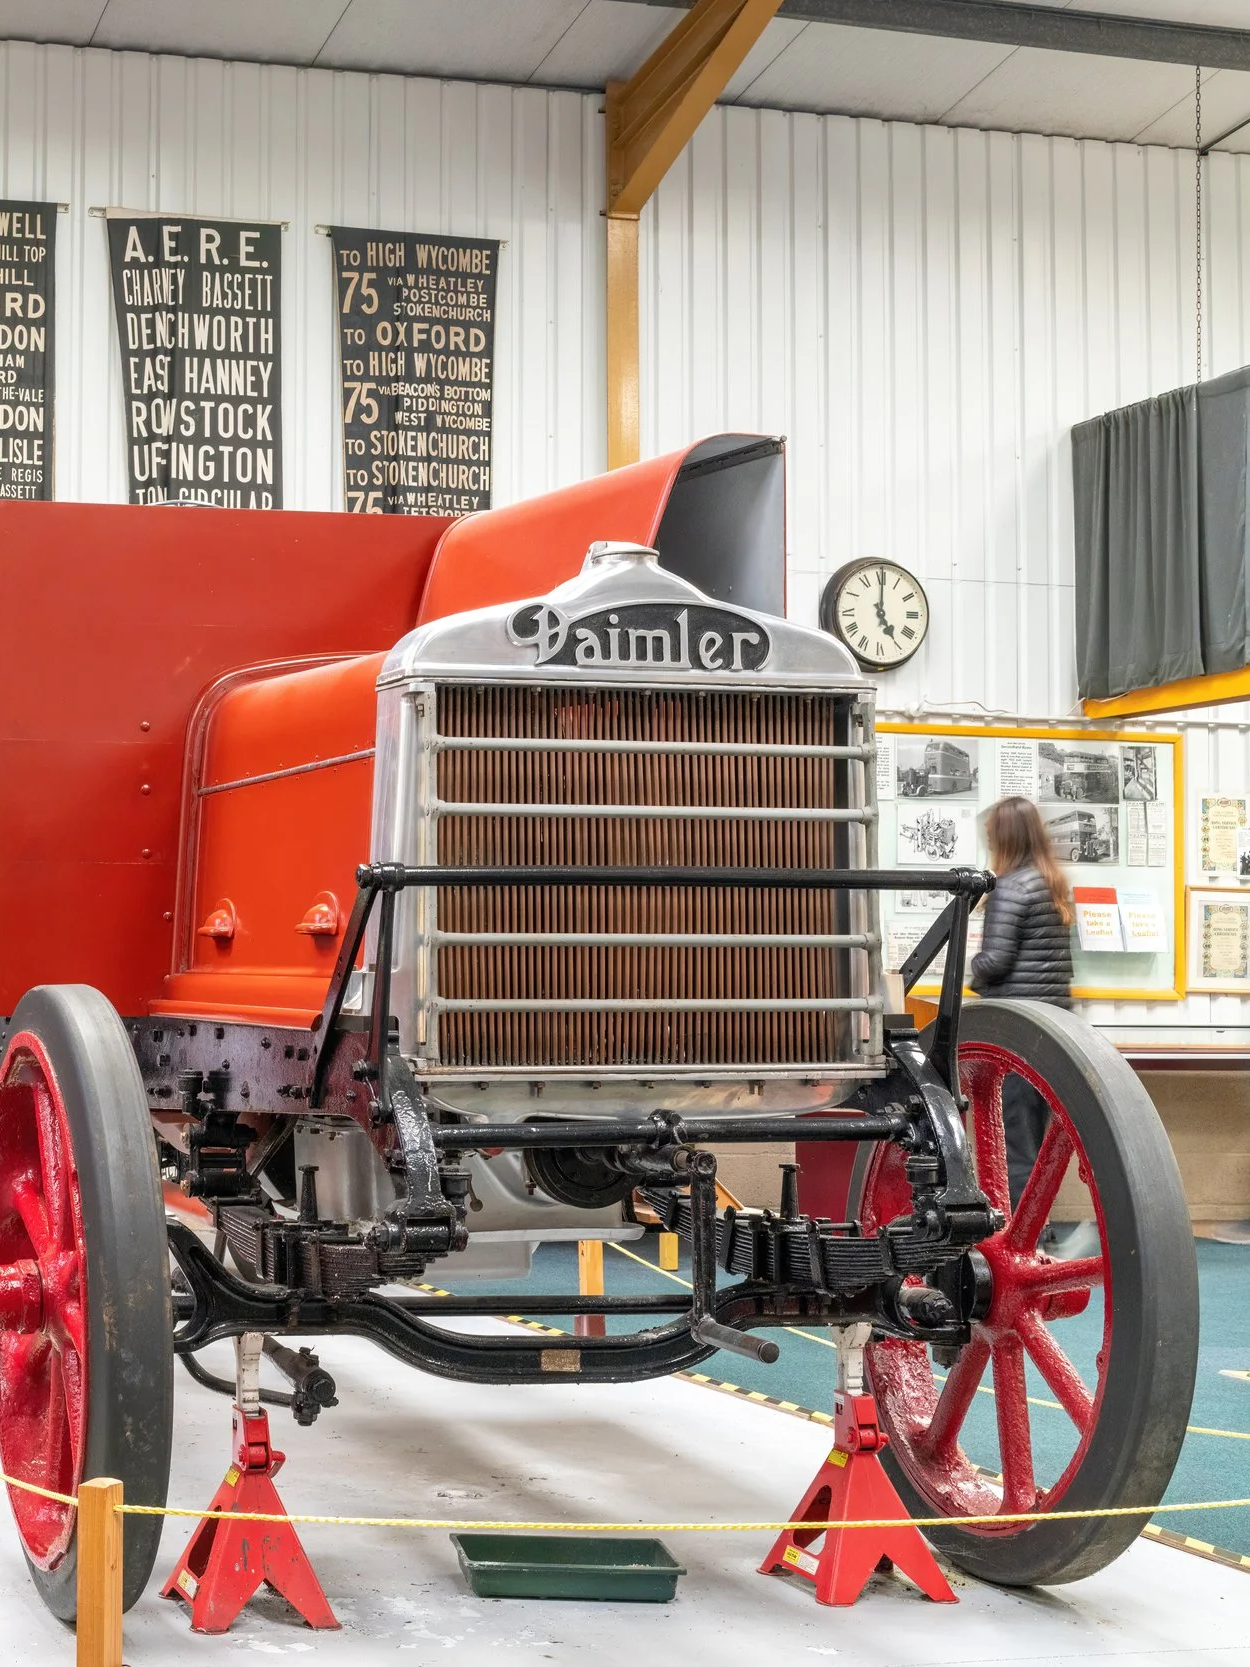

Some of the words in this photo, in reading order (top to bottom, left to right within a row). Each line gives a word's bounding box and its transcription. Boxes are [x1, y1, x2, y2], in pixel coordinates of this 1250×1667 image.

[24, 245, 46, 263] TOP
[340, 250, 361, 266] TO
[366, 241, 405, 268] HIGH
[415, 243, 491, 275] WYCOMBE
[122, 267, 185, 306] CHARNEY
[202, 271, 273, 311] BASSETT
[341, 271, 379, 315] 75
[387, 276, 403, 286] VIA
[406, 273, 484, 293] WHEATLEY
[402, 287, 488, 307] POSTCOMBE
[393, 301, 491, 322] STOKENCHURCH
[126, 310, 273, 354] DENCHWORTH
[343, 328, 366, 345] TO
[376, 321, 486, 353] OXFORD
[185, 356, 273, 398] HANNEY
[343, 360, 364, 376] TO
[369, 351, 405, 377] HIGH
[414, 352, 491, 383] WYCOMBE
[343, 381, 379, 425] 75
[378, 386, 391, 396] VIA
[391, 381, 440, 397] BEACON'S
[444, 385, 491, 401] BOTTOM
[403, 397, 482, 416] PIDDINGTON
[131, 398, 273, 441] ROWSTOCK
[394, 411, 427, 426] WEST
[436, 414, 491, 431] WYCOMBE
[346, 439, 365, 455] TO
[370, 430, 489, 461] STOKENCHURCH
[11, 468, 43, 483] REGIS
[347, 469, 368, 486] TO
[371, 460, 490, 491] STOKENCHURCH
[388, 496, 404, 506] VIA
[406, 492, 480, 509] WHEATLEY
[507, 602, 767, 671] Daimler
[1083, 910, 1111, 918] Please
